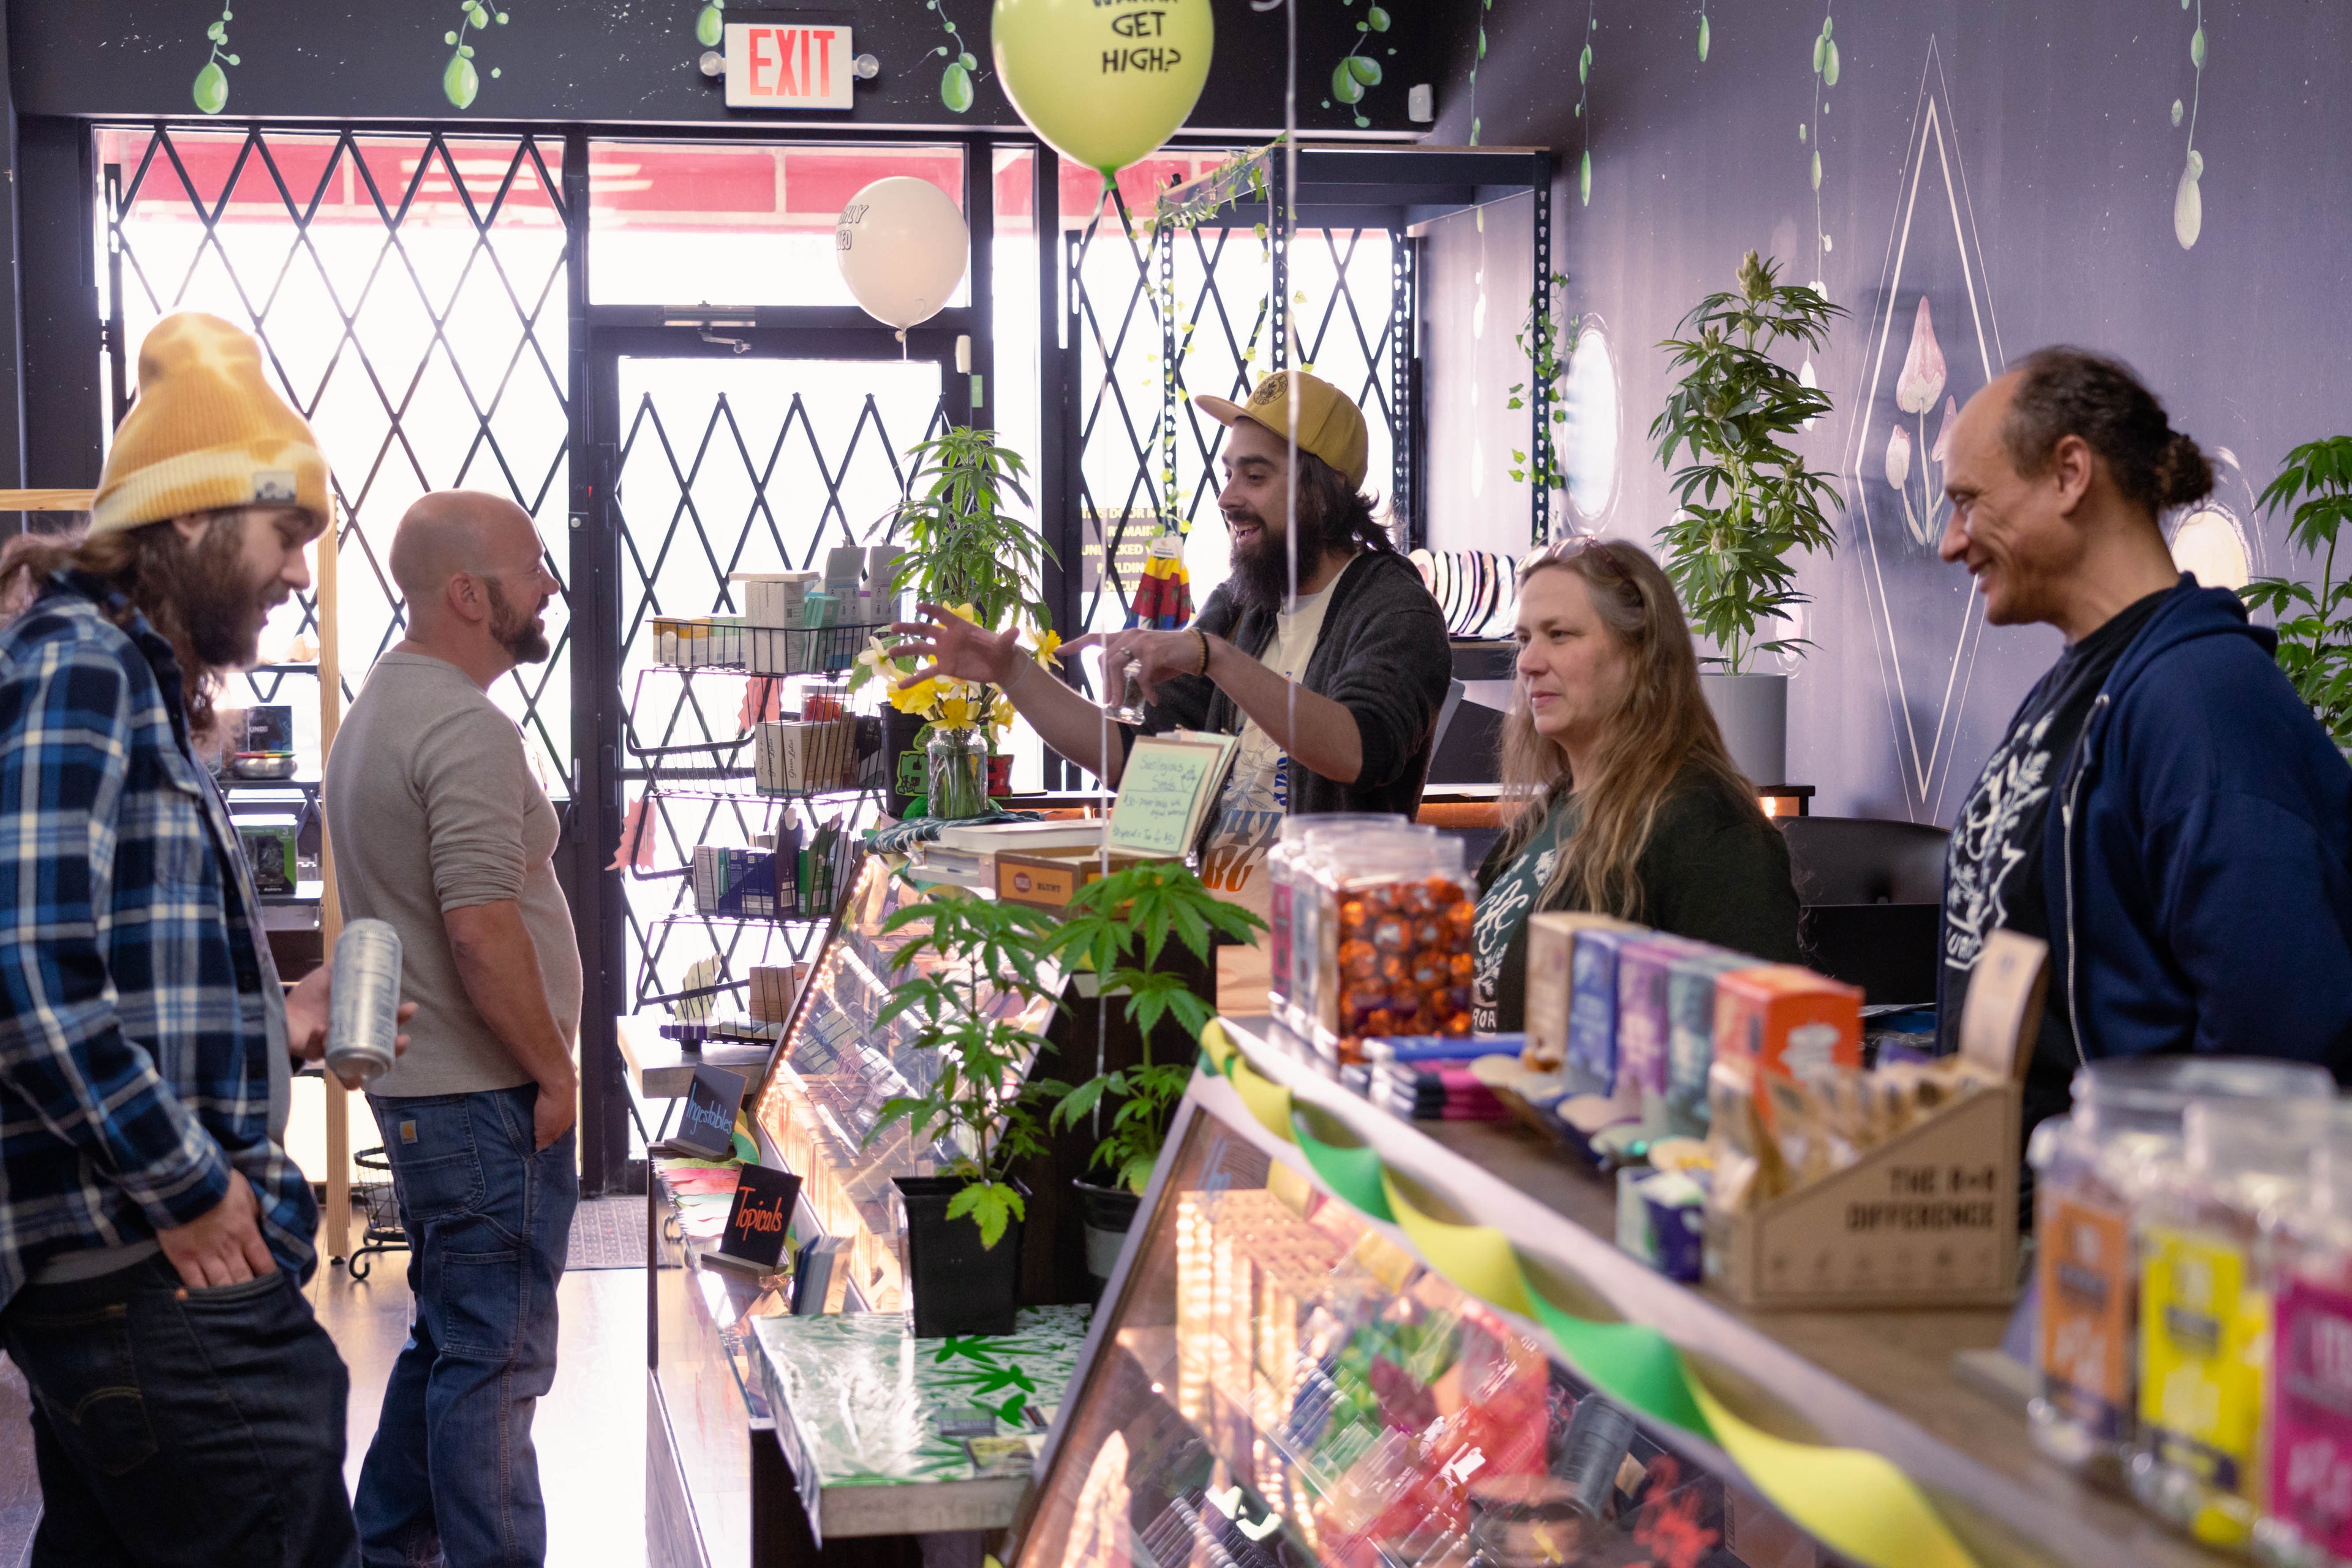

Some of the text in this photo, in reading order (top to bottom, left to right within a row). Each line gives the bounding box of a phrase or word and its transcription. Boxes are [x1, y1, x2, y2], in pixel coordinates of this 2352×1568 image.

[1112, 11, 1166, 38] GET
[749, 28, 835, 97] EXIT
[1102, 47, 1182, 74] HIGH?
[686, 1082, 733, 1134] Ingestables
[736, 1186, 783, 1242] Topicals
